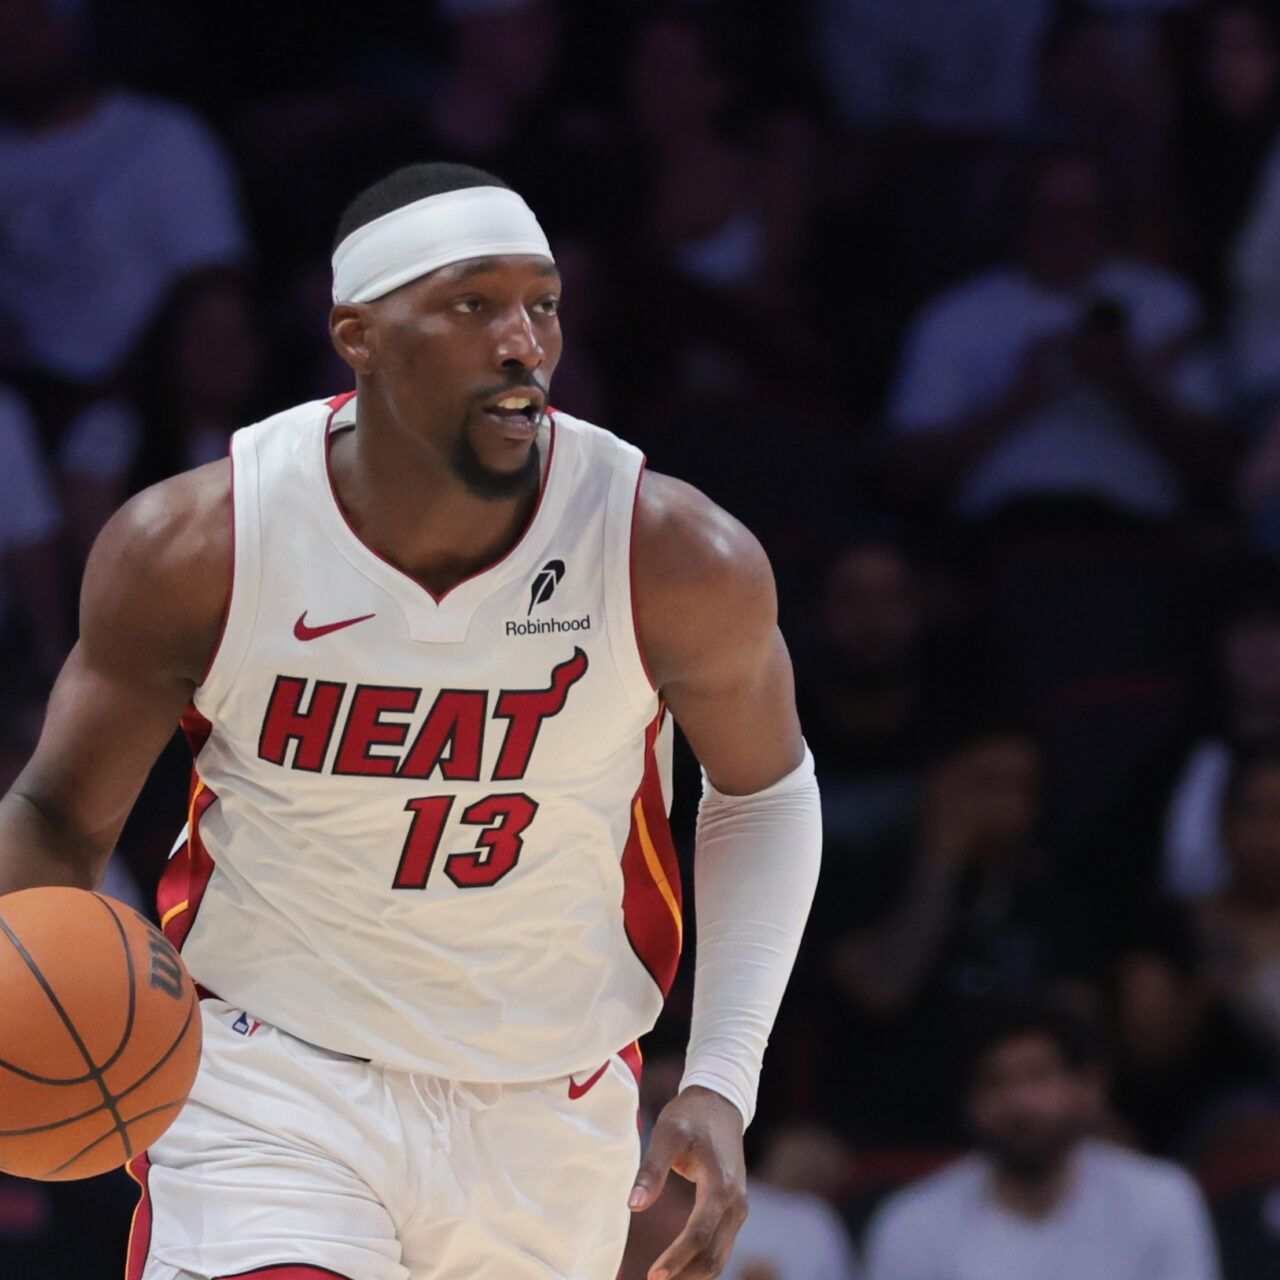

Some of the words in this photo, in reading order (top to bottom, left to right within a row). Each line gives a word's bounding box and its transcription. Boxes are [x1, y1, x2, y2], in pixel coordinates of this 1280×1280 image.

[505, 614, 591, 636] Robinhood
[258, 646, 588, 782] HEAT
[391, 792, 539, 890] 13
